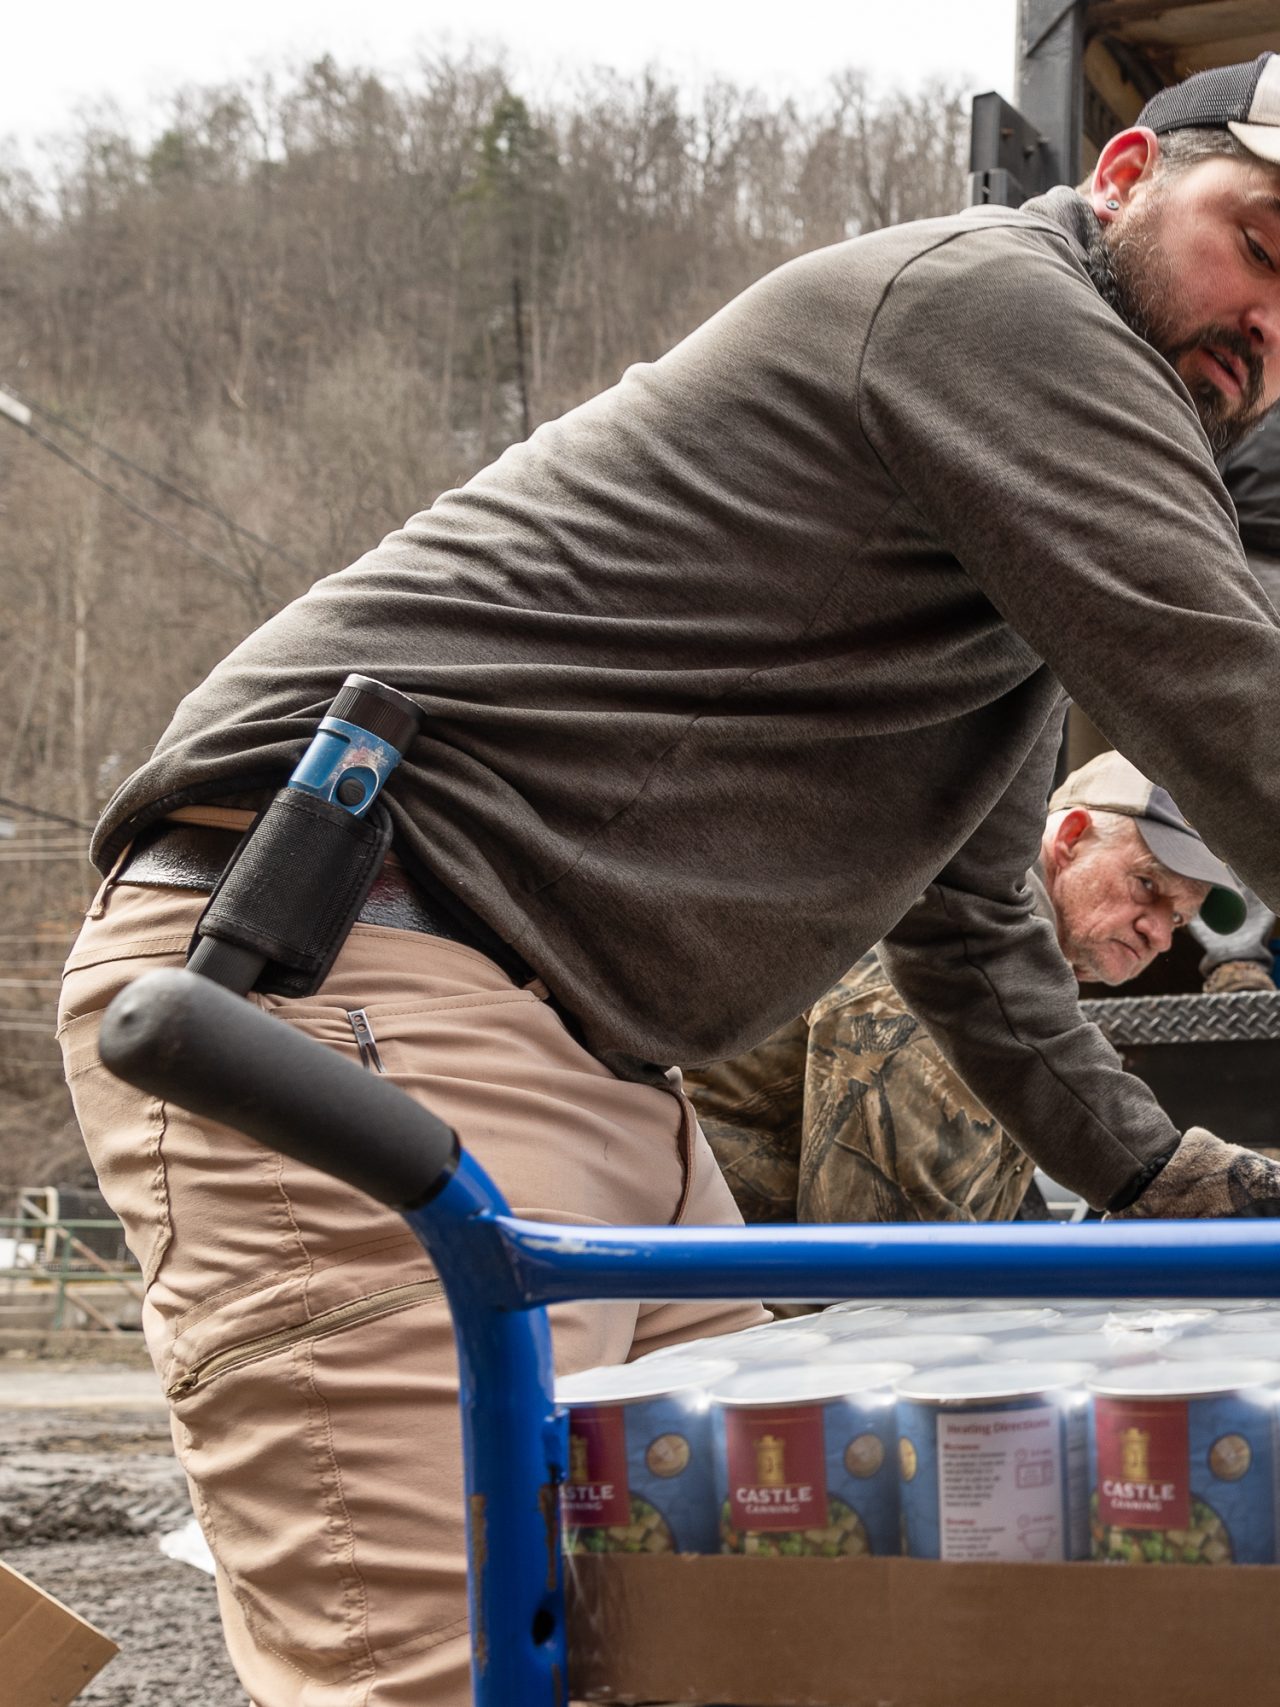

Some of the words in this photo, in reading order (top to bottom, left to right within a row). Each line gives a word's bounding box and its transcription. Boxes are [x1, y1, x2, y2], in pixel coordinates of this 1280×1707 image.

[736, 1486, 813, 1503] CASTLE
[1103, 1479, 1175, 1500] CASTLE
[745, 1504, 801, 1515] CANNING
